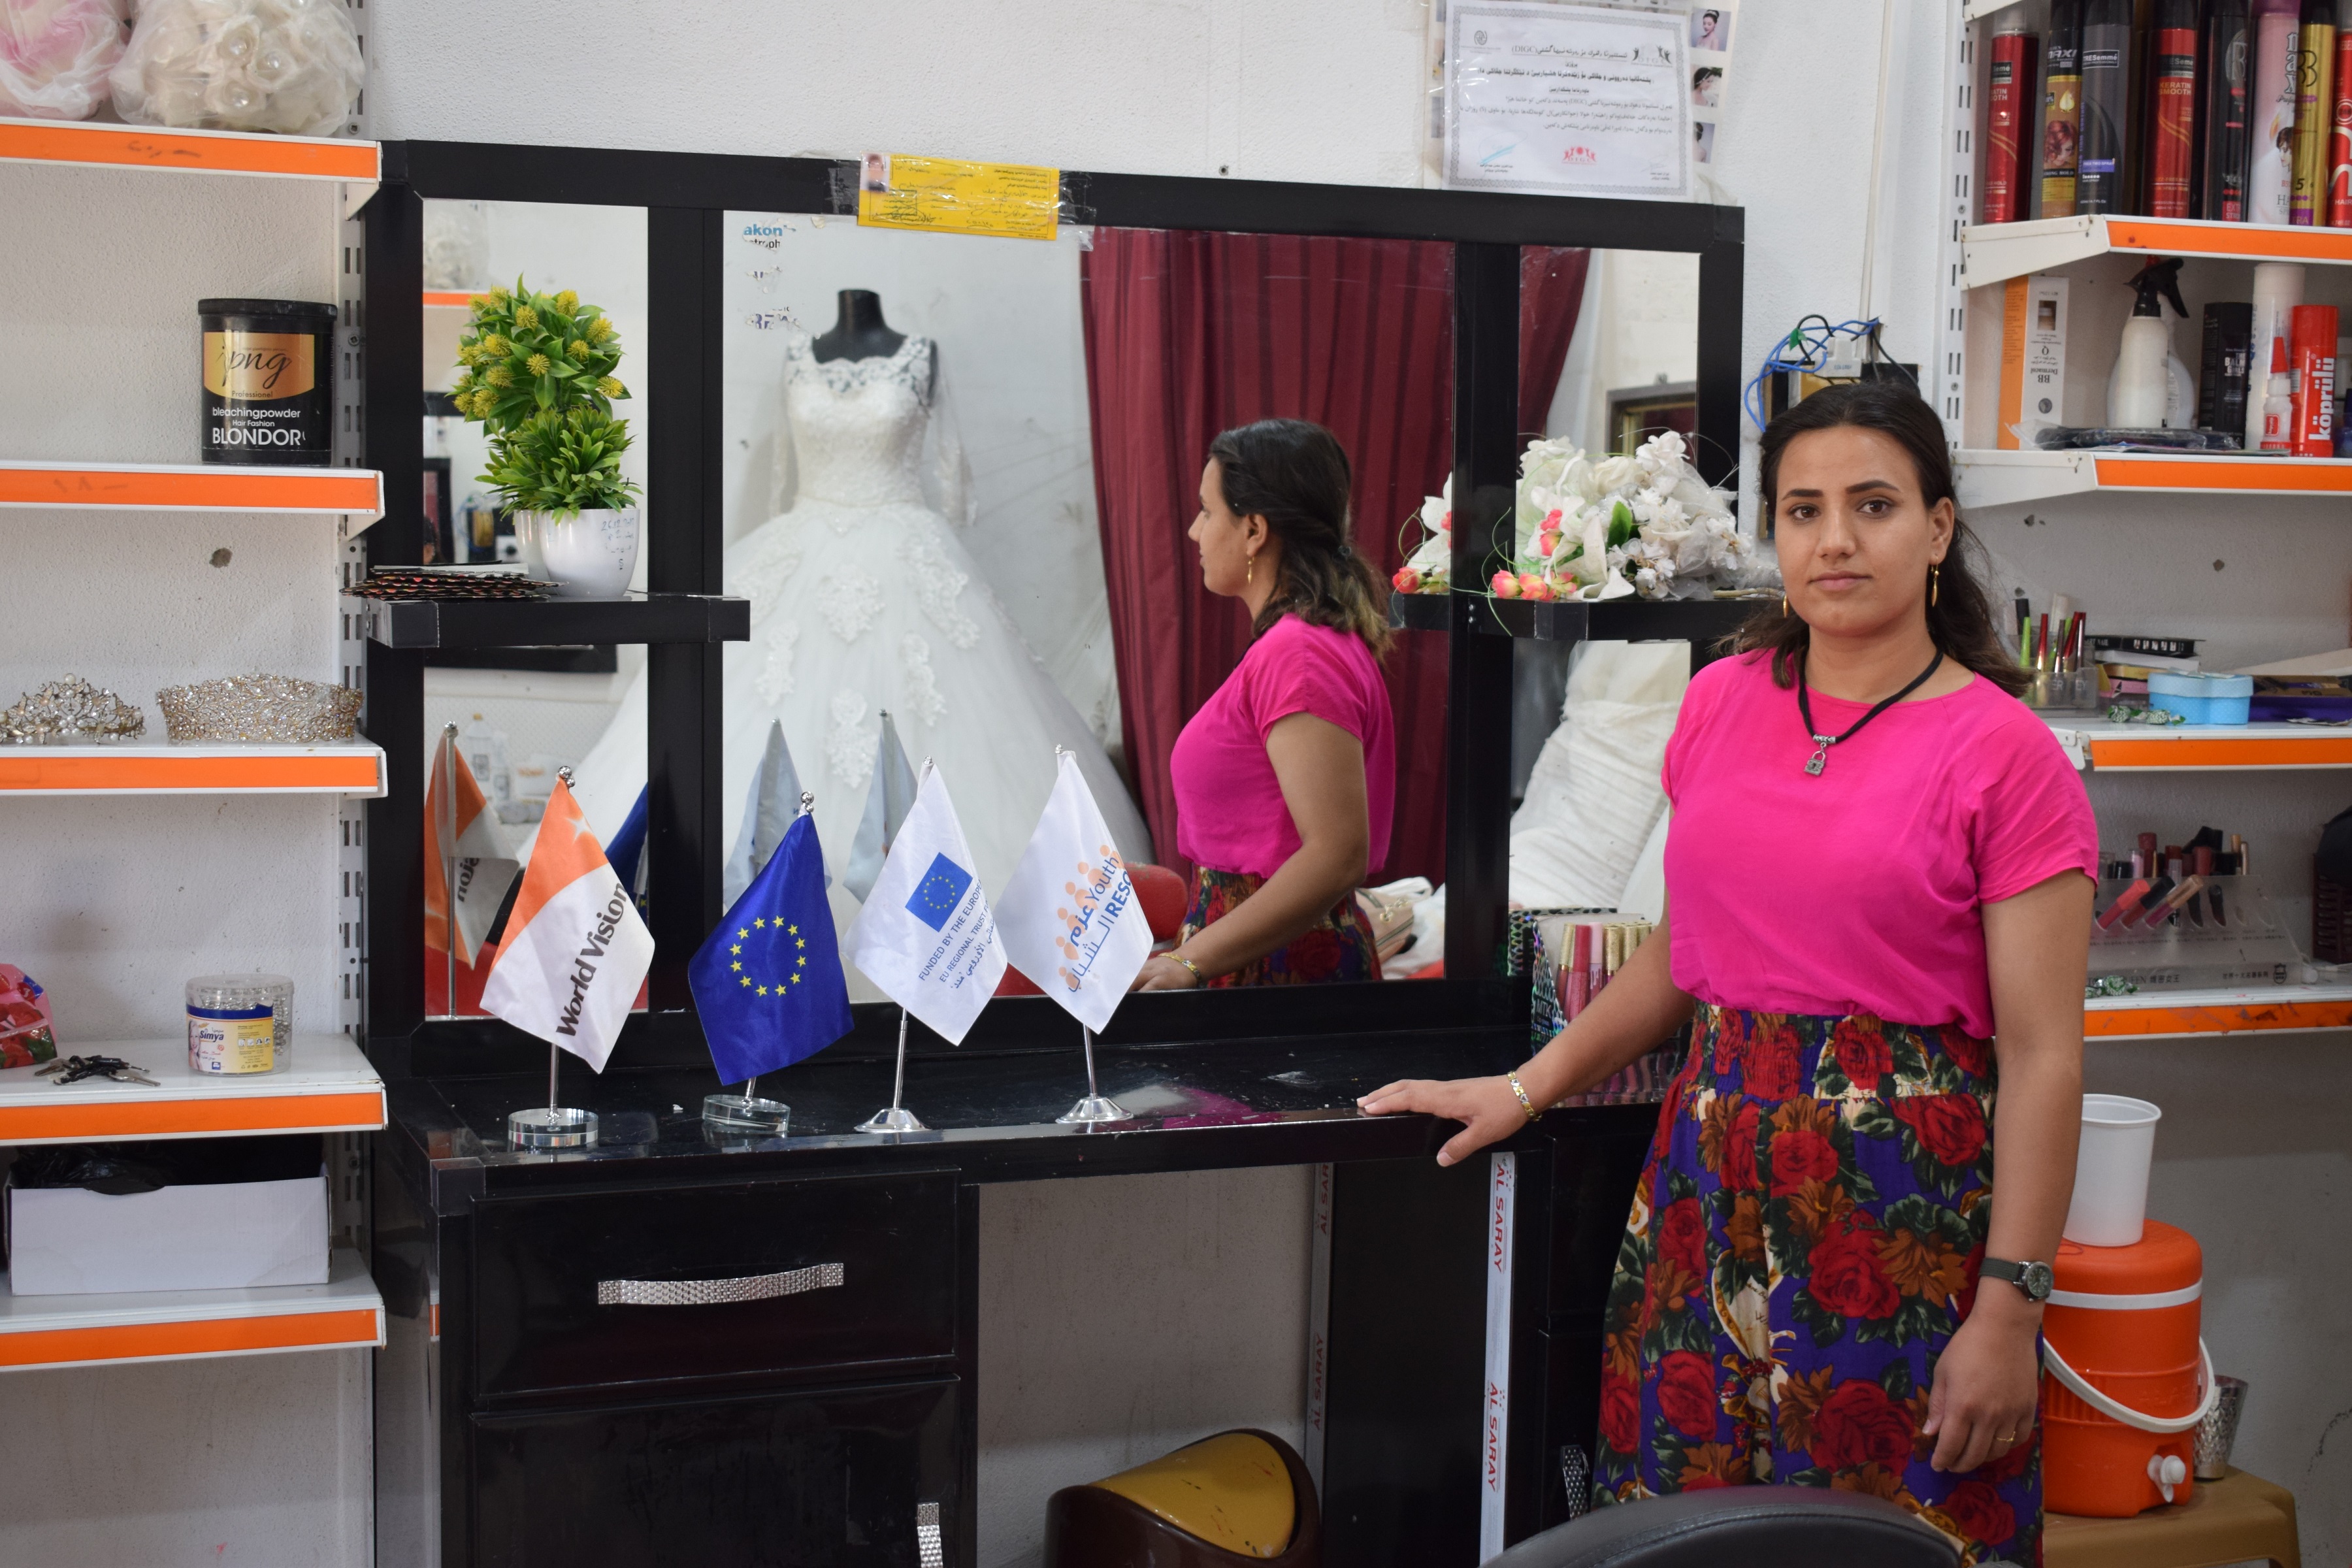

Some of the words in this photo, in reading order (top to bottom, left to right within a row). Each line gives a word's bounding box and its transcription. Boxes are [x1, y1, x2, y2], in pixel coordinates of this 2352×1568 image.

[212, 407, 301, 419] bleachingpowder
[2308, 357, 2335, 441] köprülü
[212, 428, 301, 446] BLONDOR
[1085, 857, 1119, 902] Youth
[919, 946, 945, 981] FUNDED
[942, 933, 954, 947] BY
[951, 915, 966, 934] THE
[939, 973, 949, 983] EU
[946, 936, 974, 972] REGIONAL
[971, 912, 987, 934] TRUST
[1070, 905, 1094, 947] عزم
[556, 958, 596, 1036] World
[580, 883, 627, 957] Vision
[200, 1028, 224, 1042] Simya
[1497, 1163, 1505, 1191] AL
[1494, 1196, 1504, 1273] SARAY
[1315, 1331, 1323, 1401] SARAY
[1490, 1382, 1498, 1409] AL
[1488, 1414, 1497, 1492] SARAY
